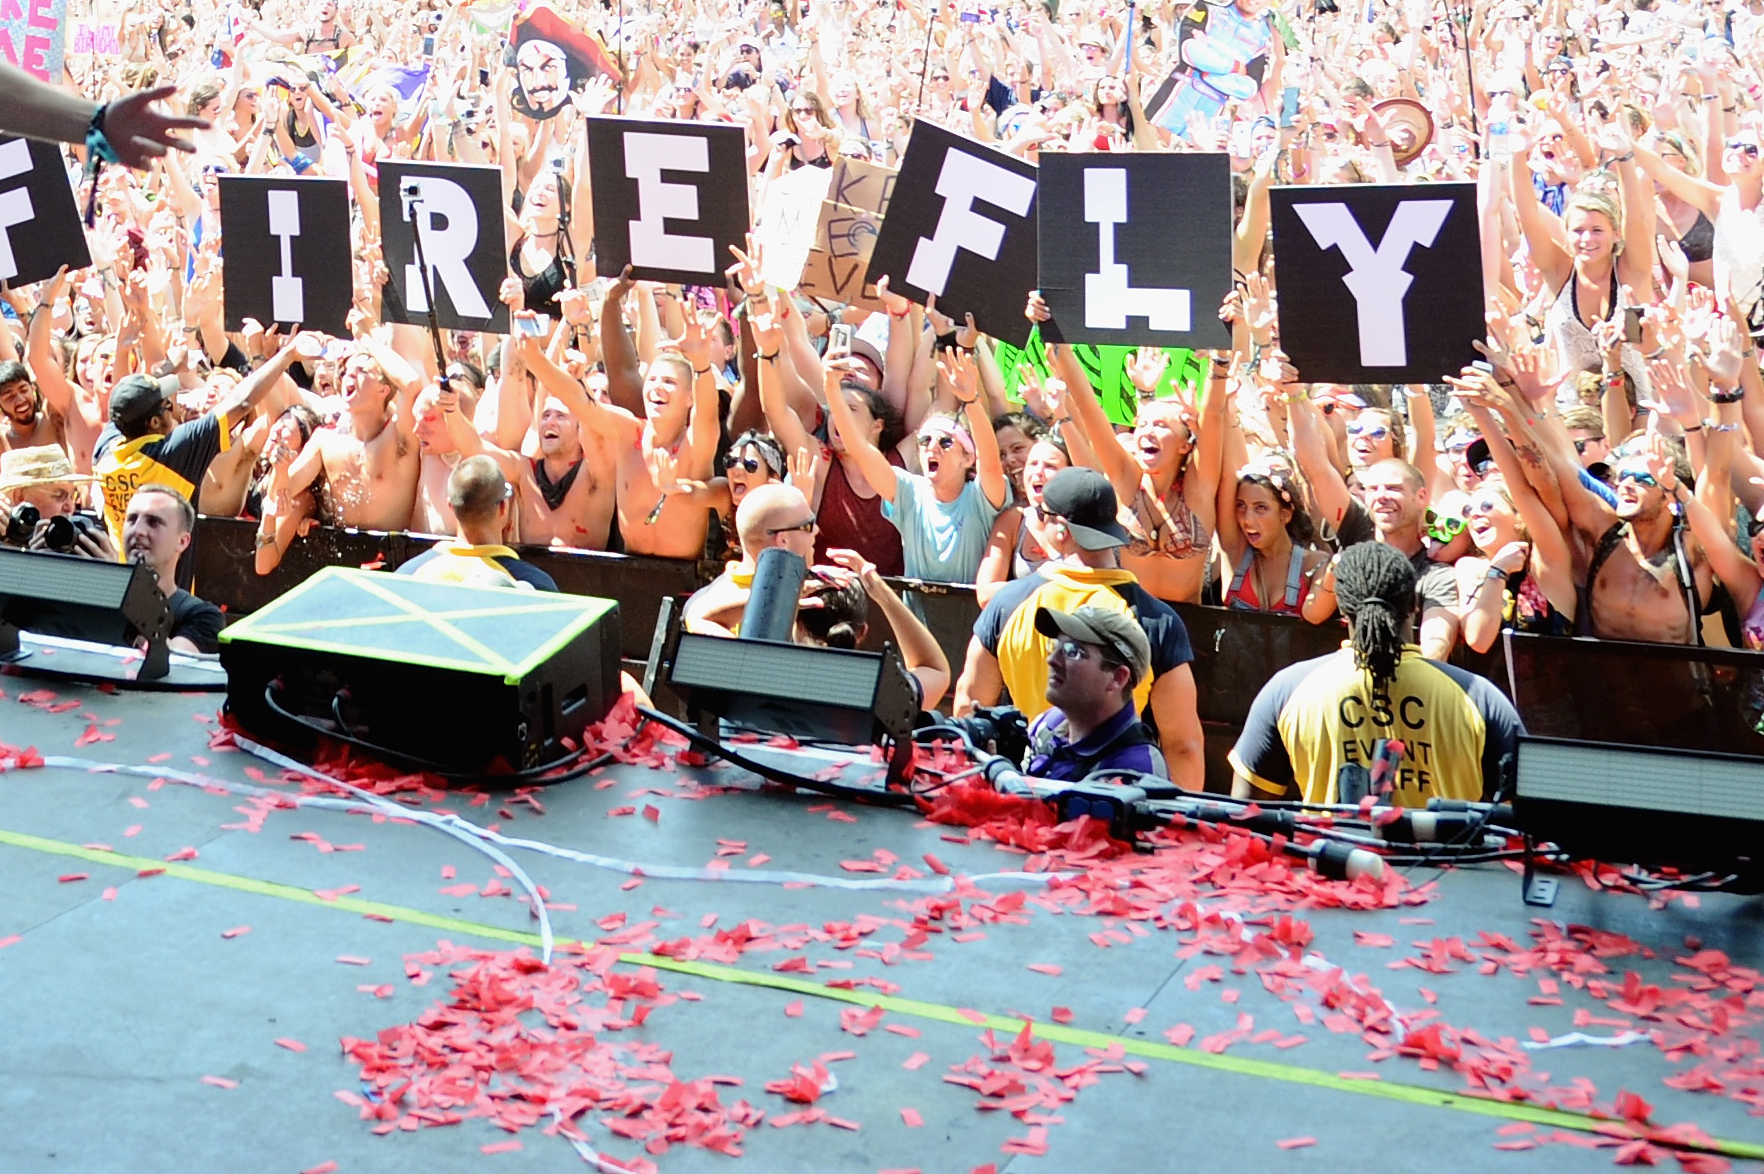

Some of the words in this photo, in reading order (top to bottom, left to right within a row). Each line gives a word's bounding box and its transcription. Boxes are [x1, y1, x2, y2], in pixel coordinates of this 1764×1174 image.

[268, 190, 304, 323] I
[400, 176, 493, 319] R
[624, 132, 716, 274] E
[905, 147, 1037, 296] F
[1084, 168, 1190, 331] L
[1293, 200, 1453, 366] Y
[105, 473, 140, 492] CSC
[1340, 695, 1425, 730] CSC
[1343, 738, 1432, 765] EVNT
